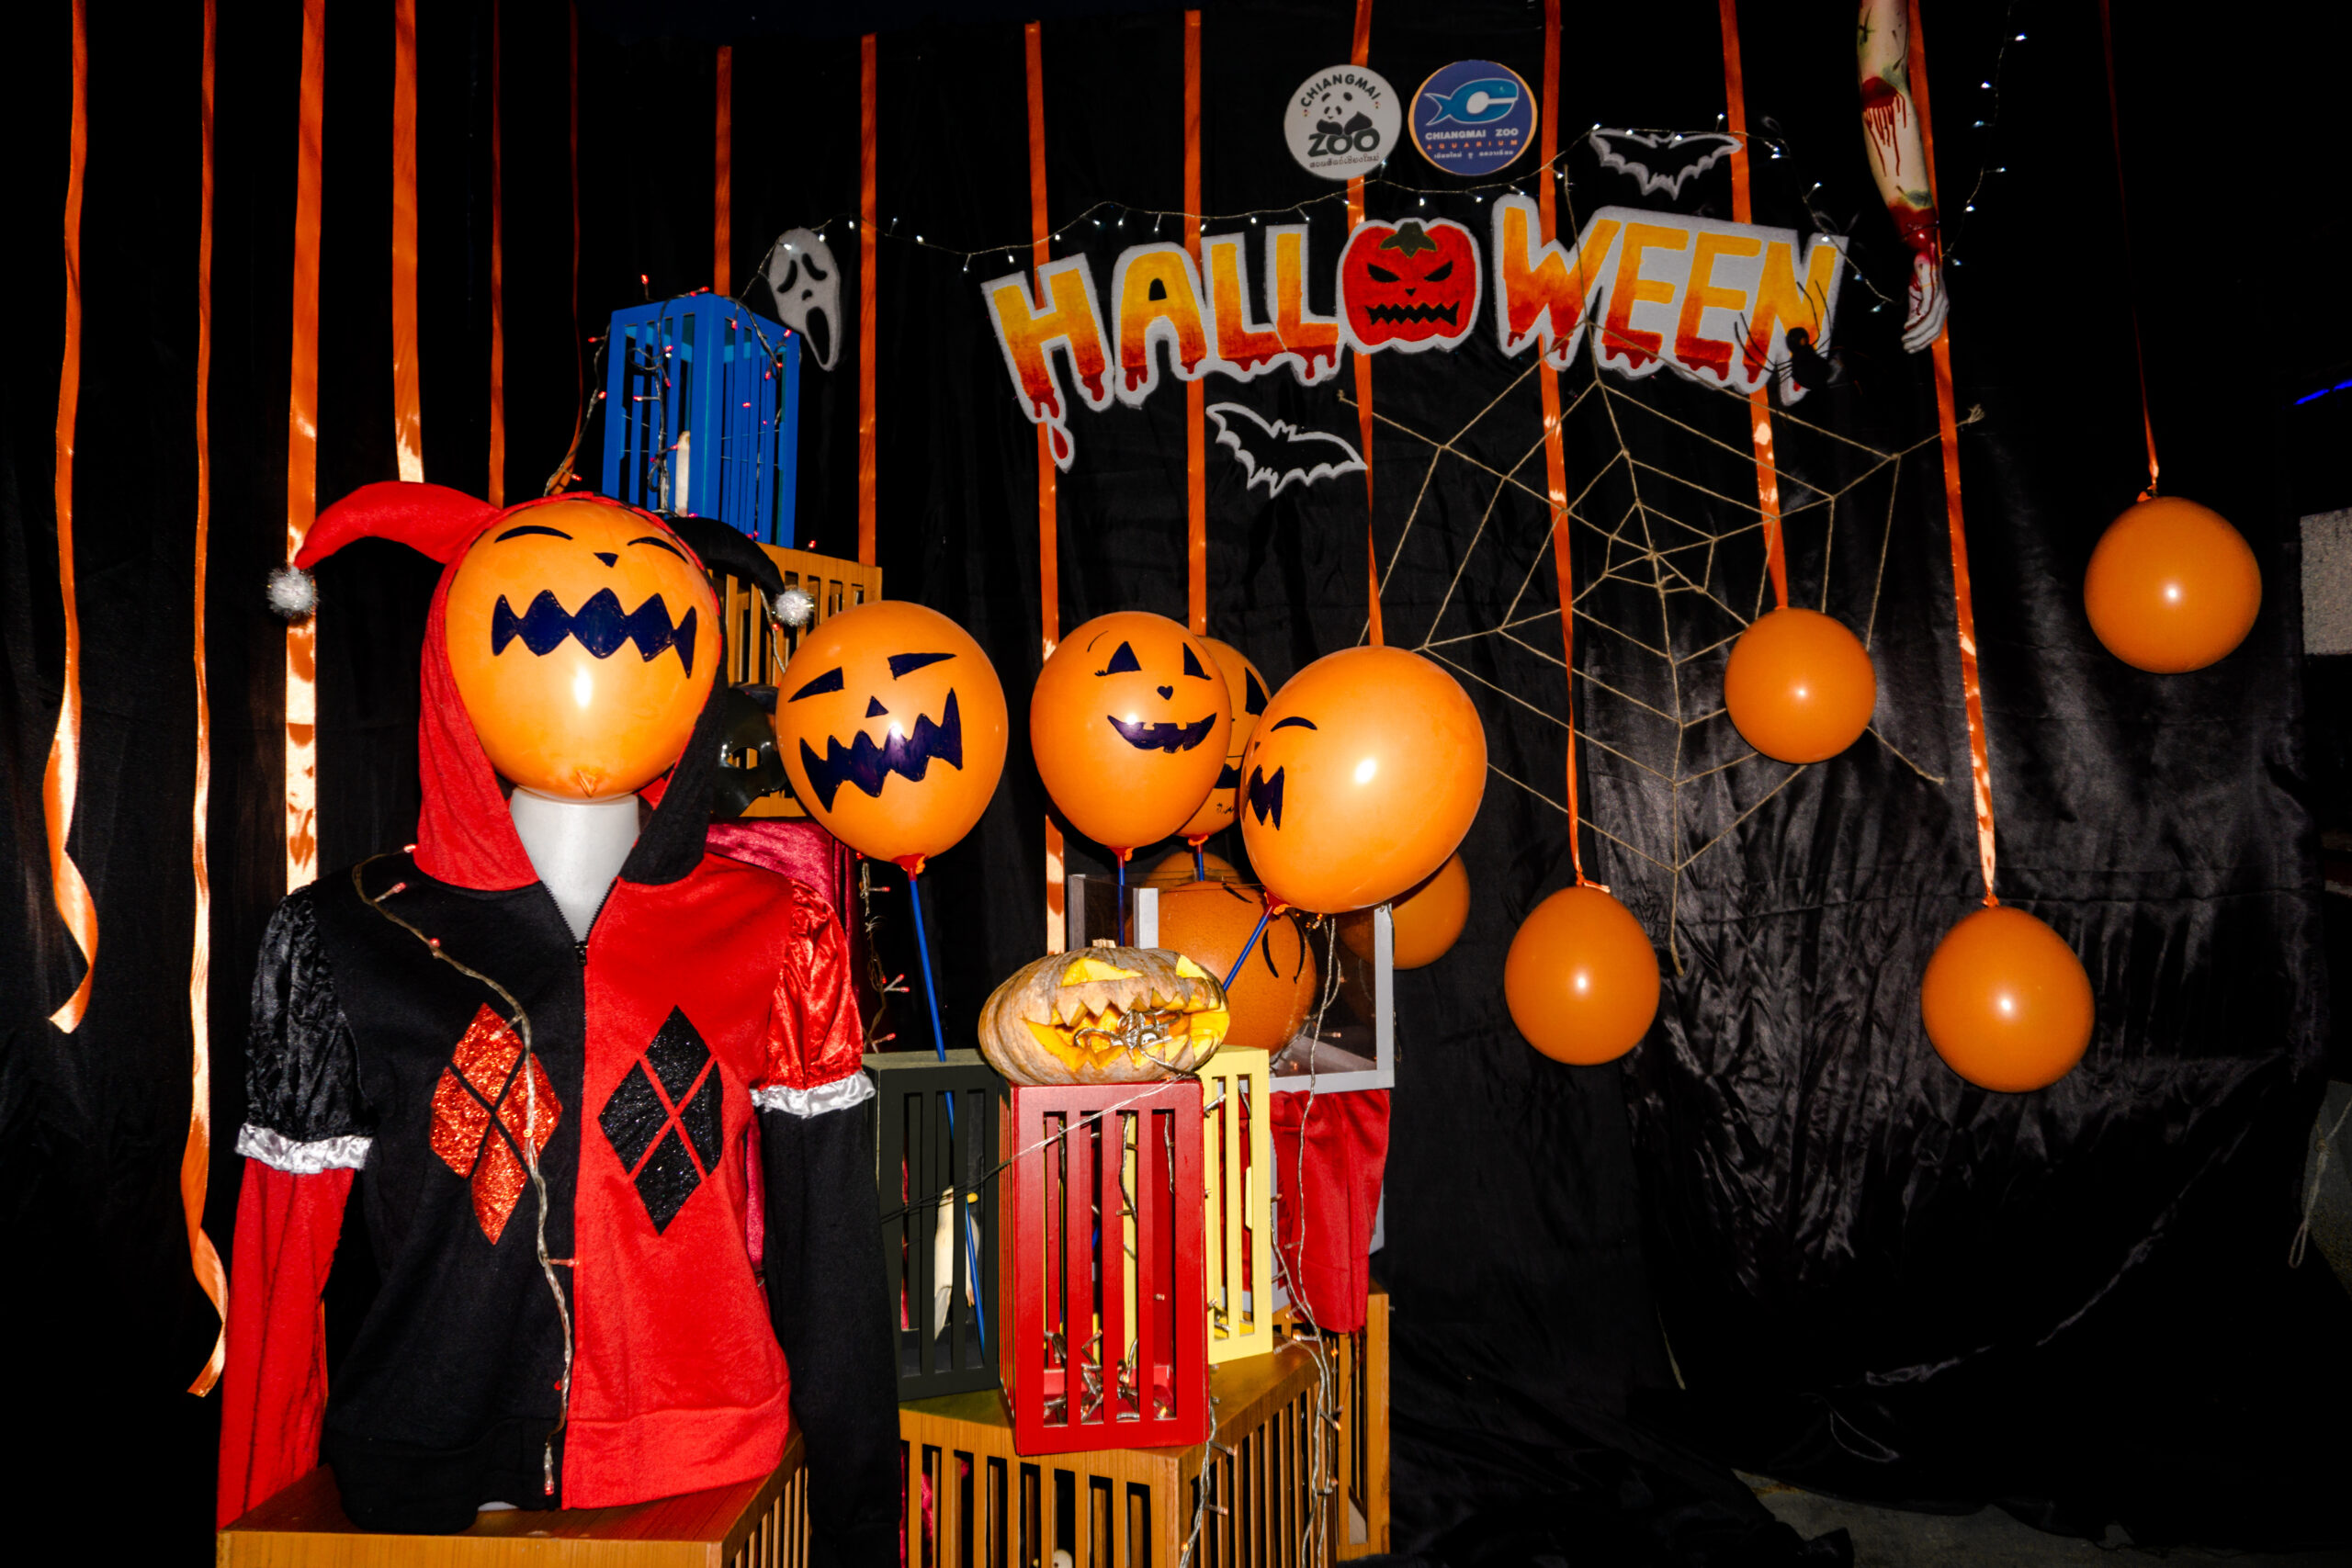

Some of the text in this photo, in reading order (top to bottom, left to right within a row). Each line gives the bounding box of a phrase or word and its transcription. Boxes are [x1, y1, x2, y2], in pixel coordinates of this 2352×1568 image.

[1300, 73, 1382, 107] CHIANGMAI
[1306, 127, 1381, 158] ZOO
[1424, 128, 1520, 141] CHIANGMAI ZOO
[1426, 139, 1519, 150] AQUARIUM
